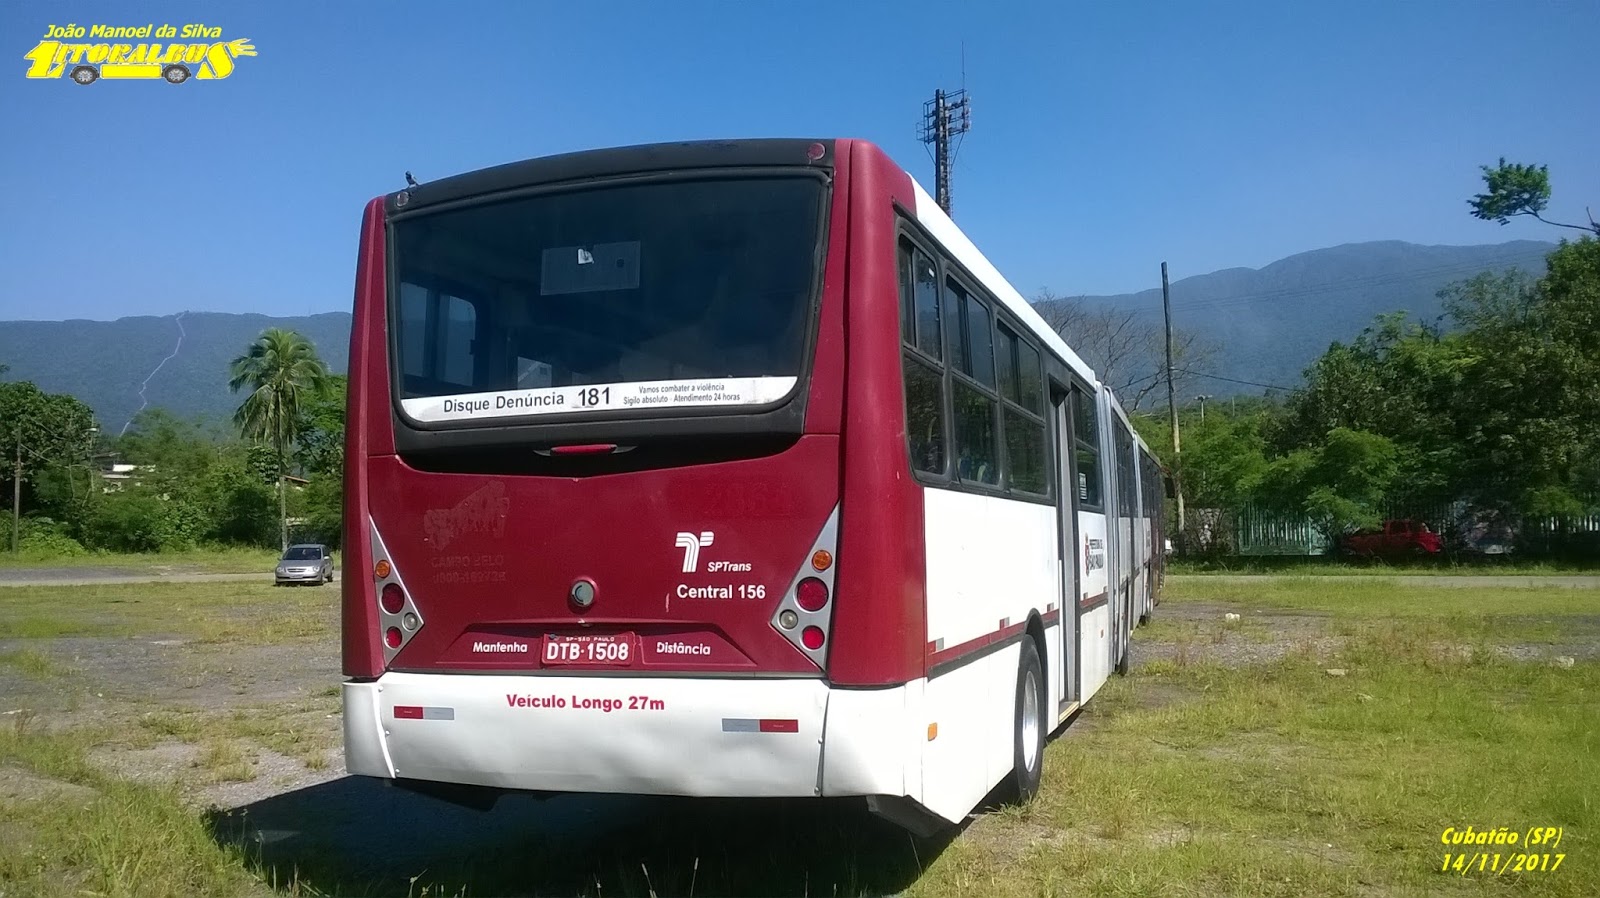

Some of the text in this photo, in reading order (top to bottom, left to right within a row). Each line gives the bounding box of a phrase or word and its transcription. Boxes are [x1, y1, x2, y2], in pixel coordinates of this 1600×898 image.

[638, 385, 660, 394] Vamos
[660, 384, 691, 393] combater
[696, 383, 725, 391] violência
[443, 387, 611, 414] Disque Denúncia 181
[623, 396, 641, 406] Sigilo
[641, 395, 669, 404] absoluto
[673, 393, 713, 402] Atendimento
[713, 393, 722, 401] 24
[722, 393, 741, 401] horas
[707, 561, 752, 572] SPTrans
[676, 584, 766, 599] Central 156
[472, 641, 528, 653] Mantenha
[656, 641, 711, 655] Distância
[506, 694, 665, 712] Veículo Longo 27m
